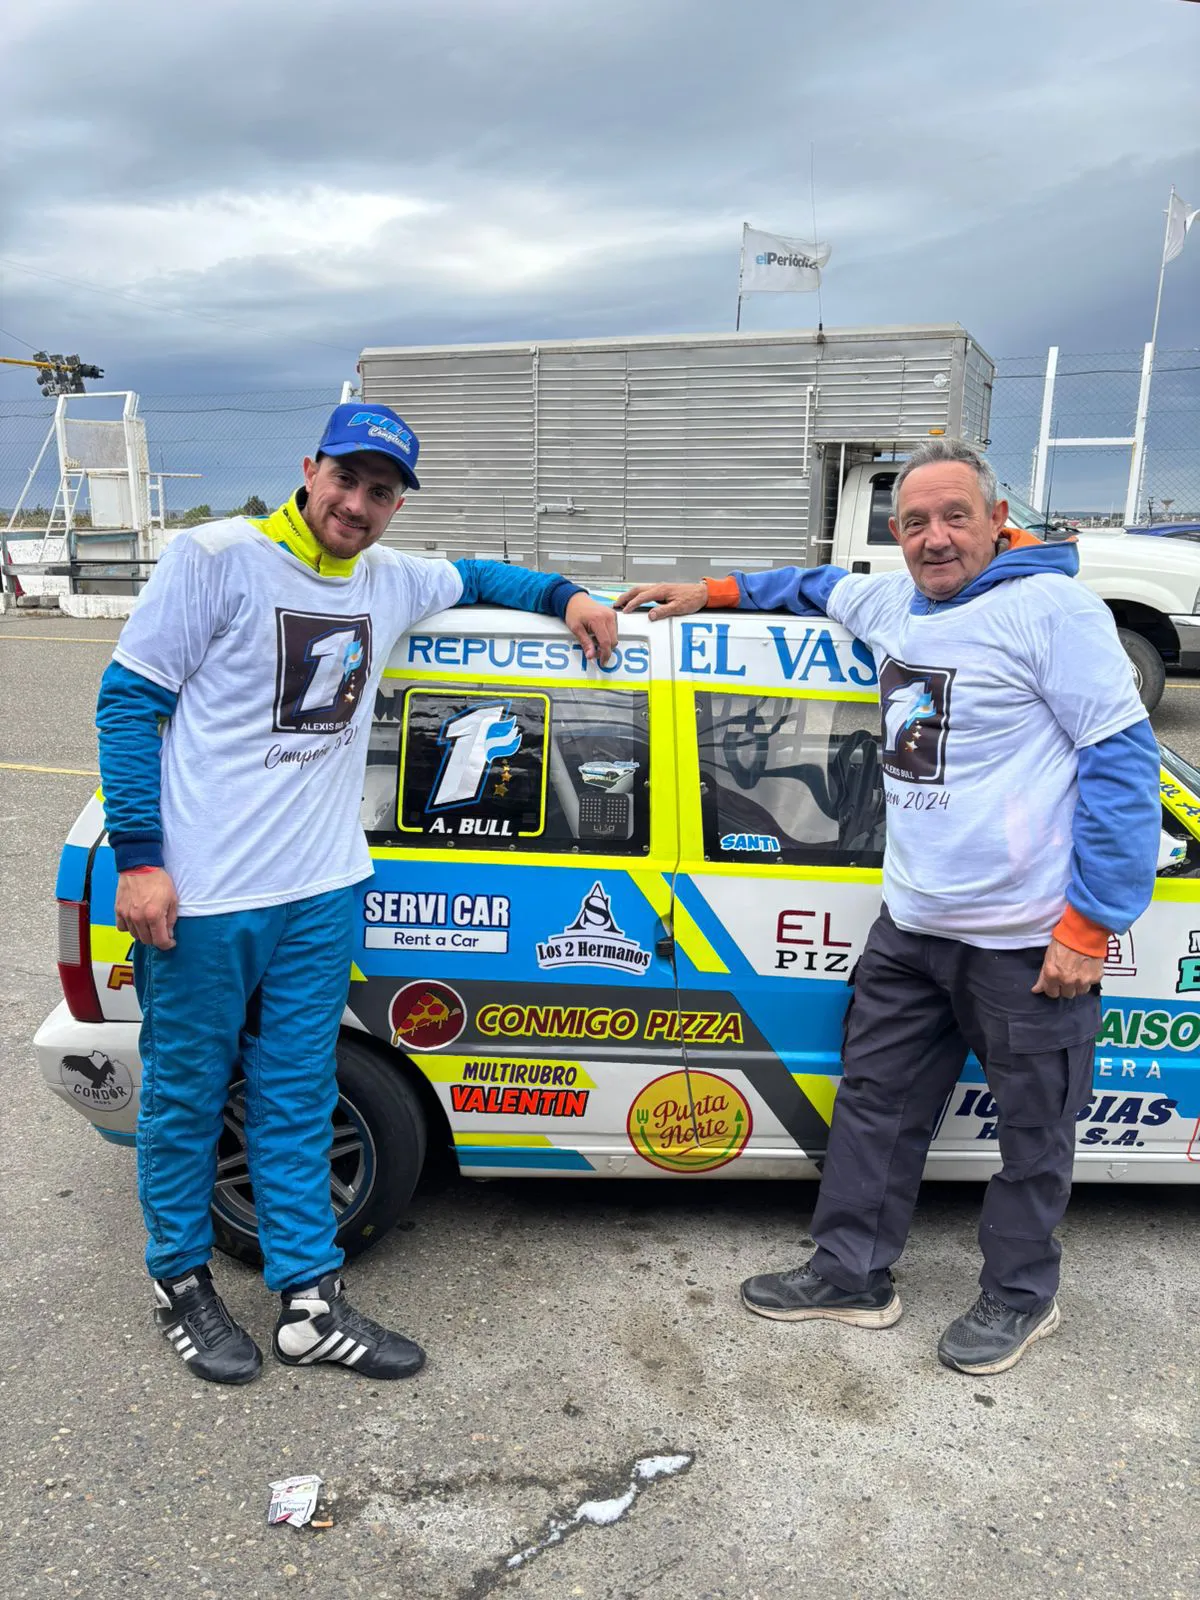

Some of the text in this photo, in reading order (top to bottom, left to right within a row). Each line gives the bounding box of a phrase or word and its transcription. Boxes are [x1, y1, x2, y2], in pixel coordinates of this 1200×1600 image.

[407, 635, 650, 674] REPUESTOS
[679, 622, 746, 676] EL
[300, 722, 335, 731] ALEXIS
[901, 768, 915, 780] BULL
[903, 790, 951, 810] 2024
[428, 817, 513, 837] A. BULL
[720, 833, 781, 852] SANTI
[363, 891, 510, 928] SERVI CAR
[394, 931, 480, 949] Rent a Car
[776, 910, 852, 948] EL
[537, 941, 650, 967] Los 2 Hermanos
[775, 949, 849, 973] PIZ
[476, 1004, 744, 1043] CONMIGO PIZZA
[463, 1062, 577, 1087] MULTIRUBRO
[74, 1083, 128, 1100] CONDOR
[450, 1085, 590, 1117] VALENTIN
[653, 1095, 729, 1128] Punta
[660, 1118, 728, 1148] Norte
